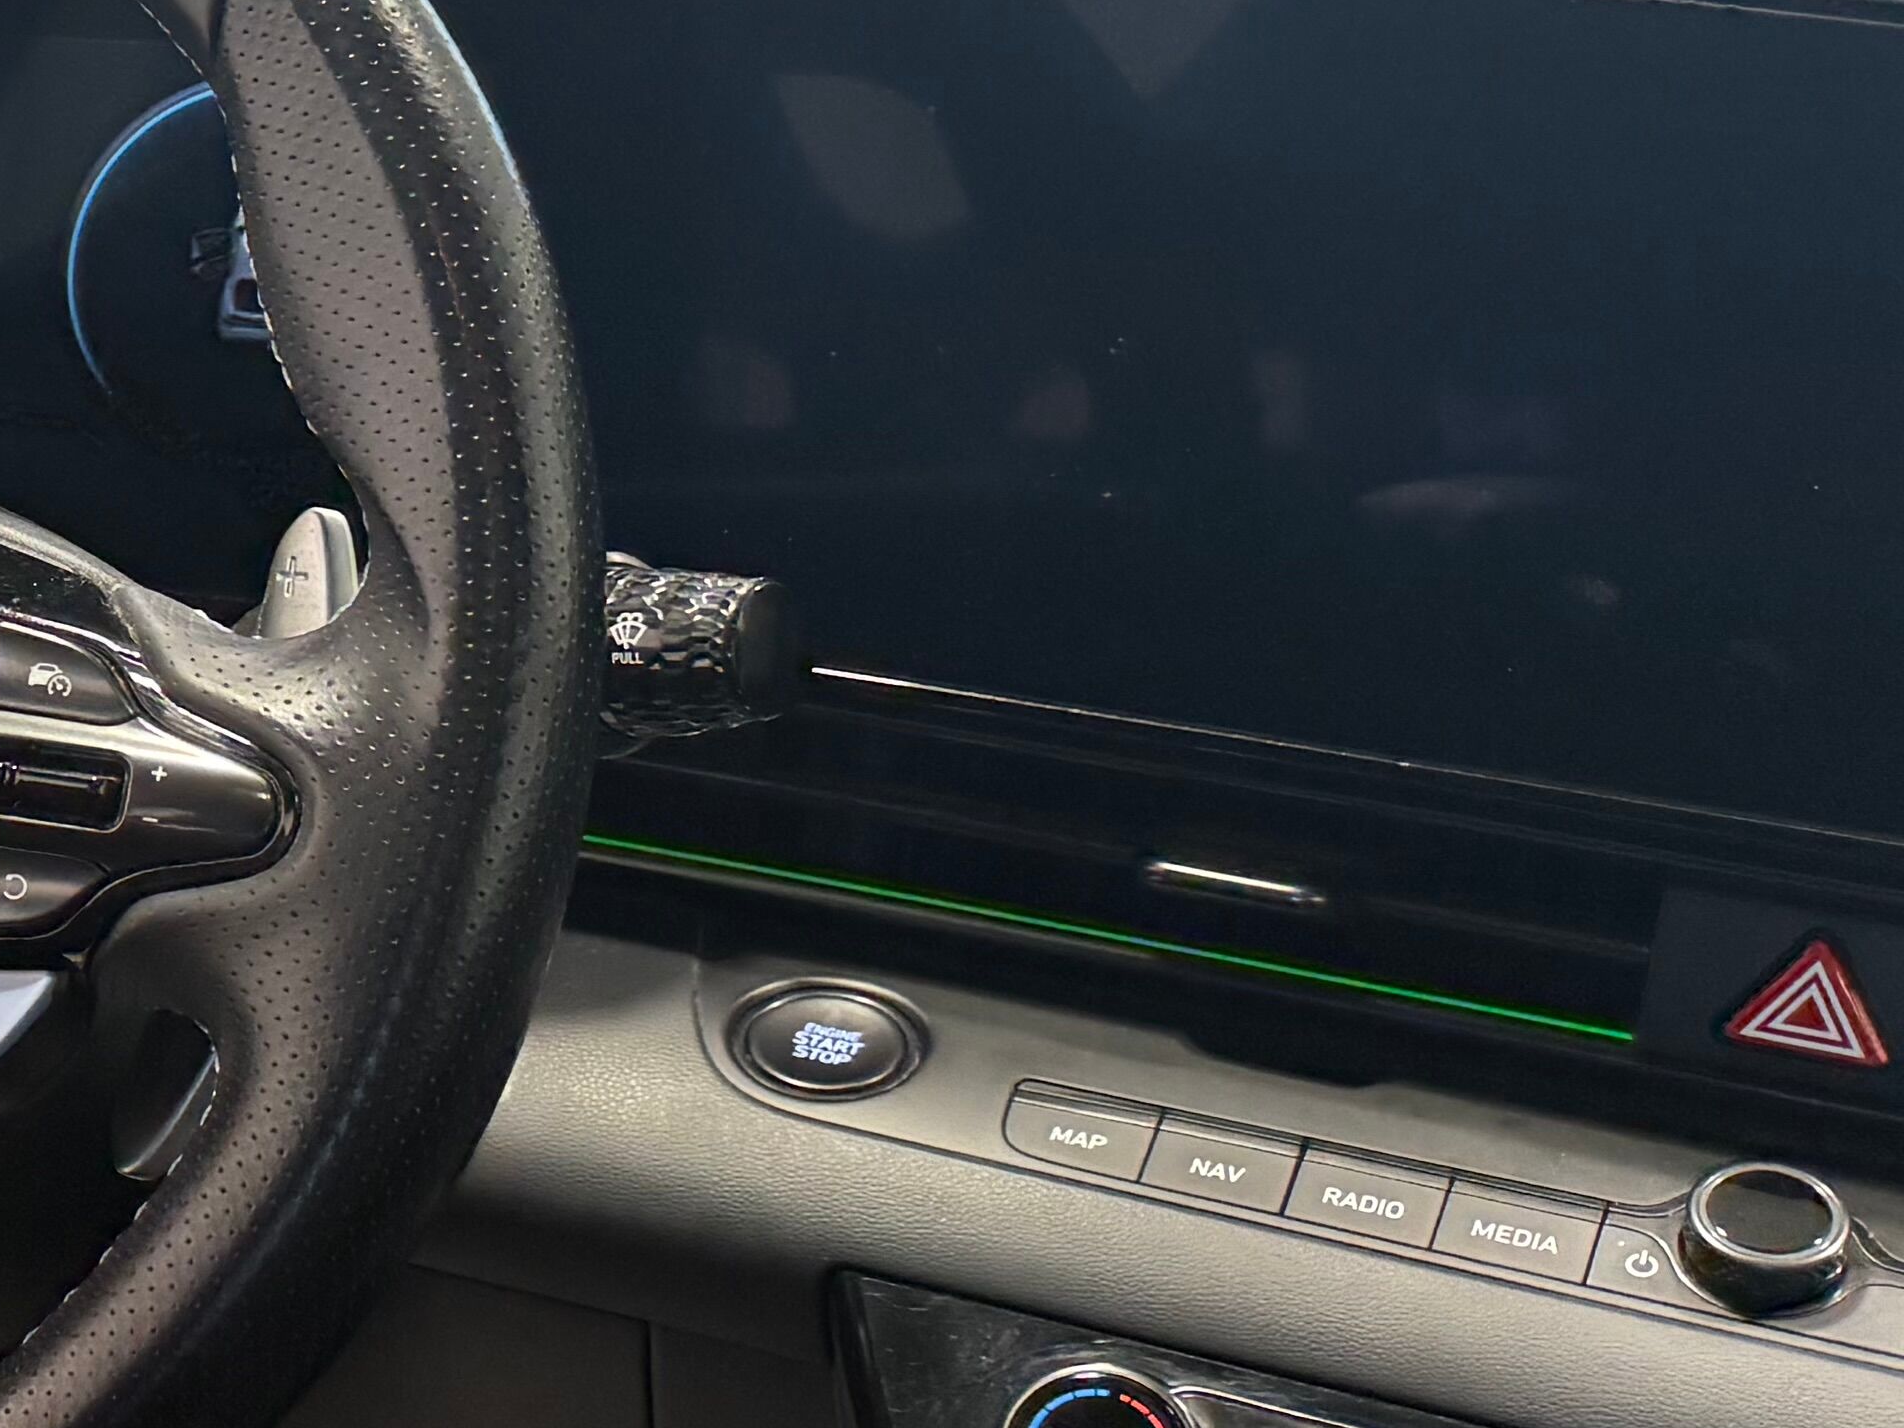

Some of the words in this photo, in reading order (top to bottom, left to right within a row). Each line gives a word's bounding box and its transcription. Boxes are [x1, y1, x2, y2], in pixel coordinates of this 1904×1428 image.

[611, 651, 644, 665] PULL
[792, 1031, 865, 1055] START
[804, 1022, 864, 1042] ENGINE
[792, 1045, 853, 1065] STOP
[1048, 1125, 1108, 1153] MAP
[1189, 1157, 1247, 1184] NAV
[1321, 1186, 1406, 1221] RADIO
[1469, 1219, 1560, 1257] MEDIA
